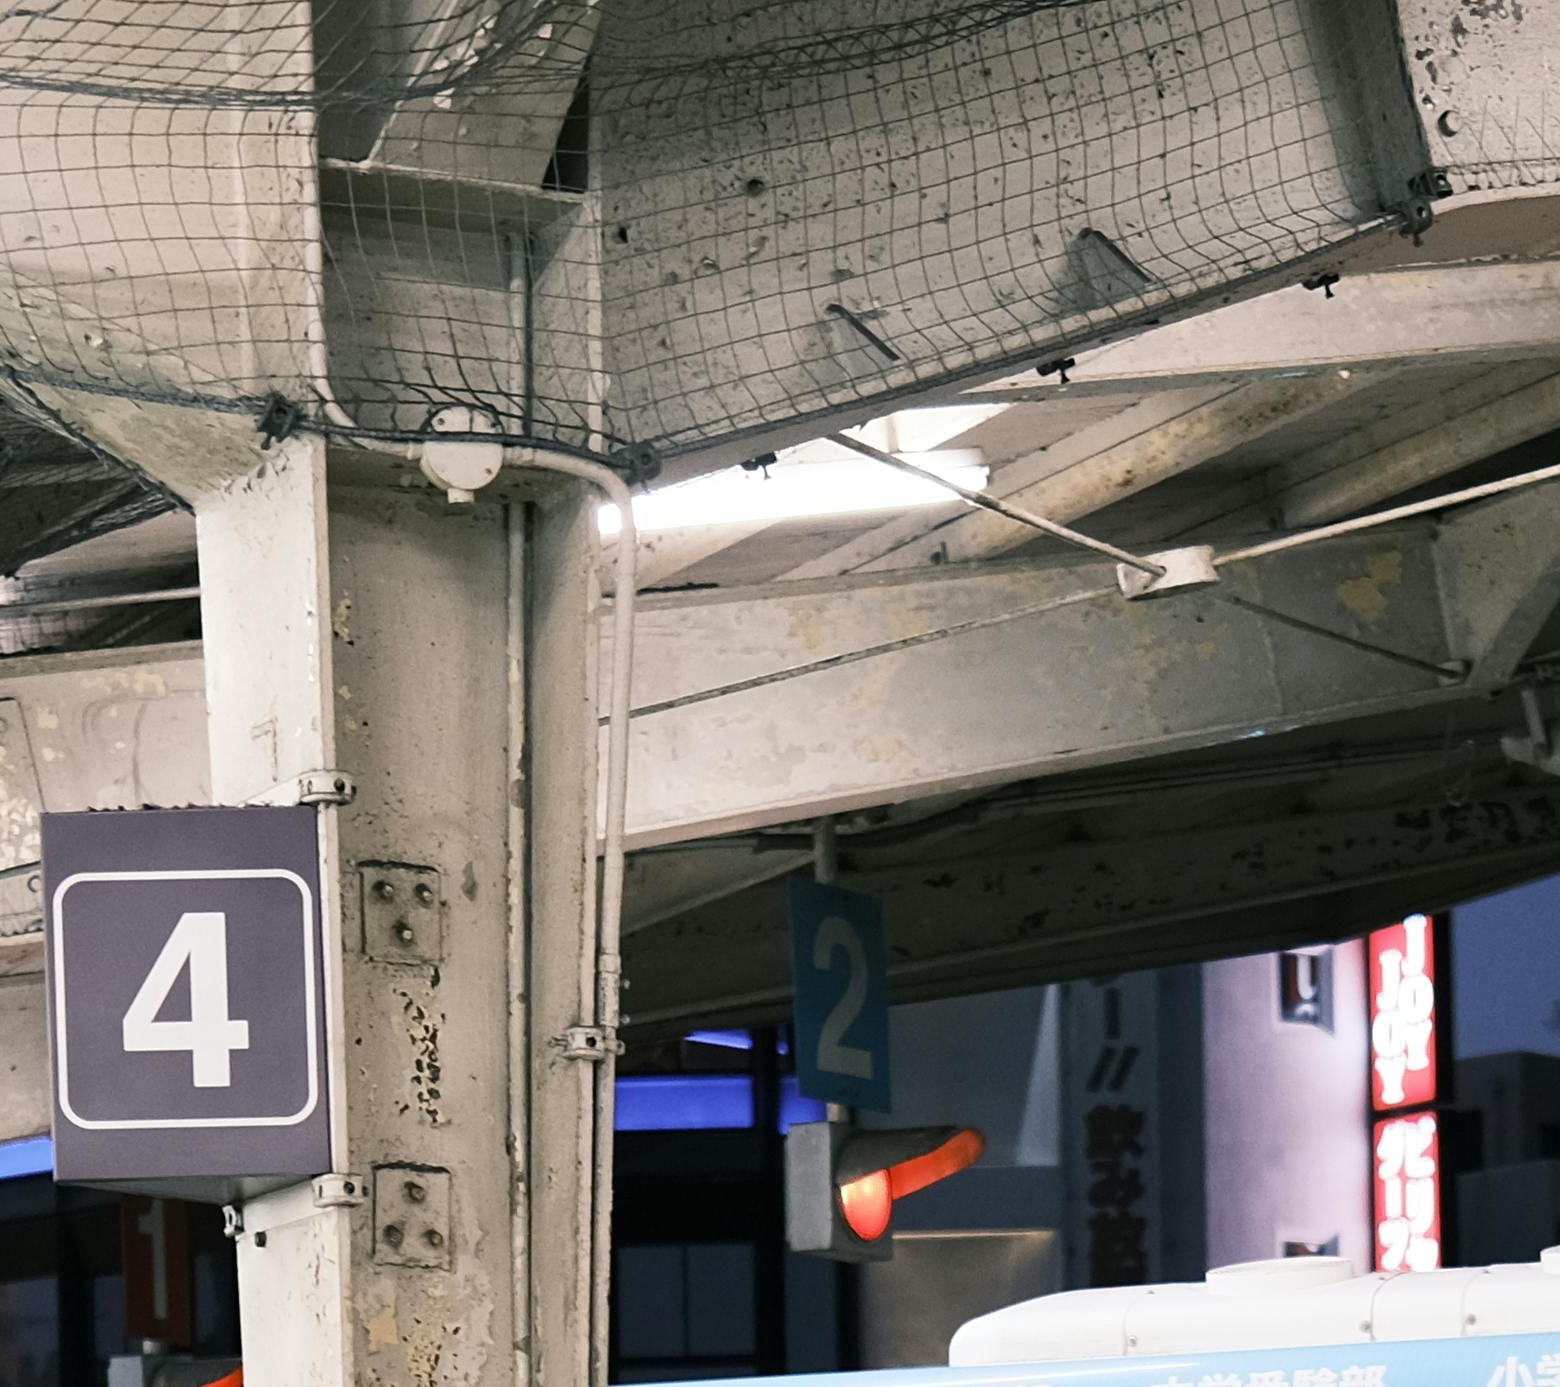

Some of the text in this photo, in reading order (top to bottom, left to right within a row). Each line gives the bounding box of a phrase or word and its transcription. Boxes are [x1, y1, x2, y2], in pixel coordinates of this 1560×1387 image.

[122, 912, 249, 1087] 4
[814, 916, 874, 1080] 2
[137, 1199, 169, 1320] 1
